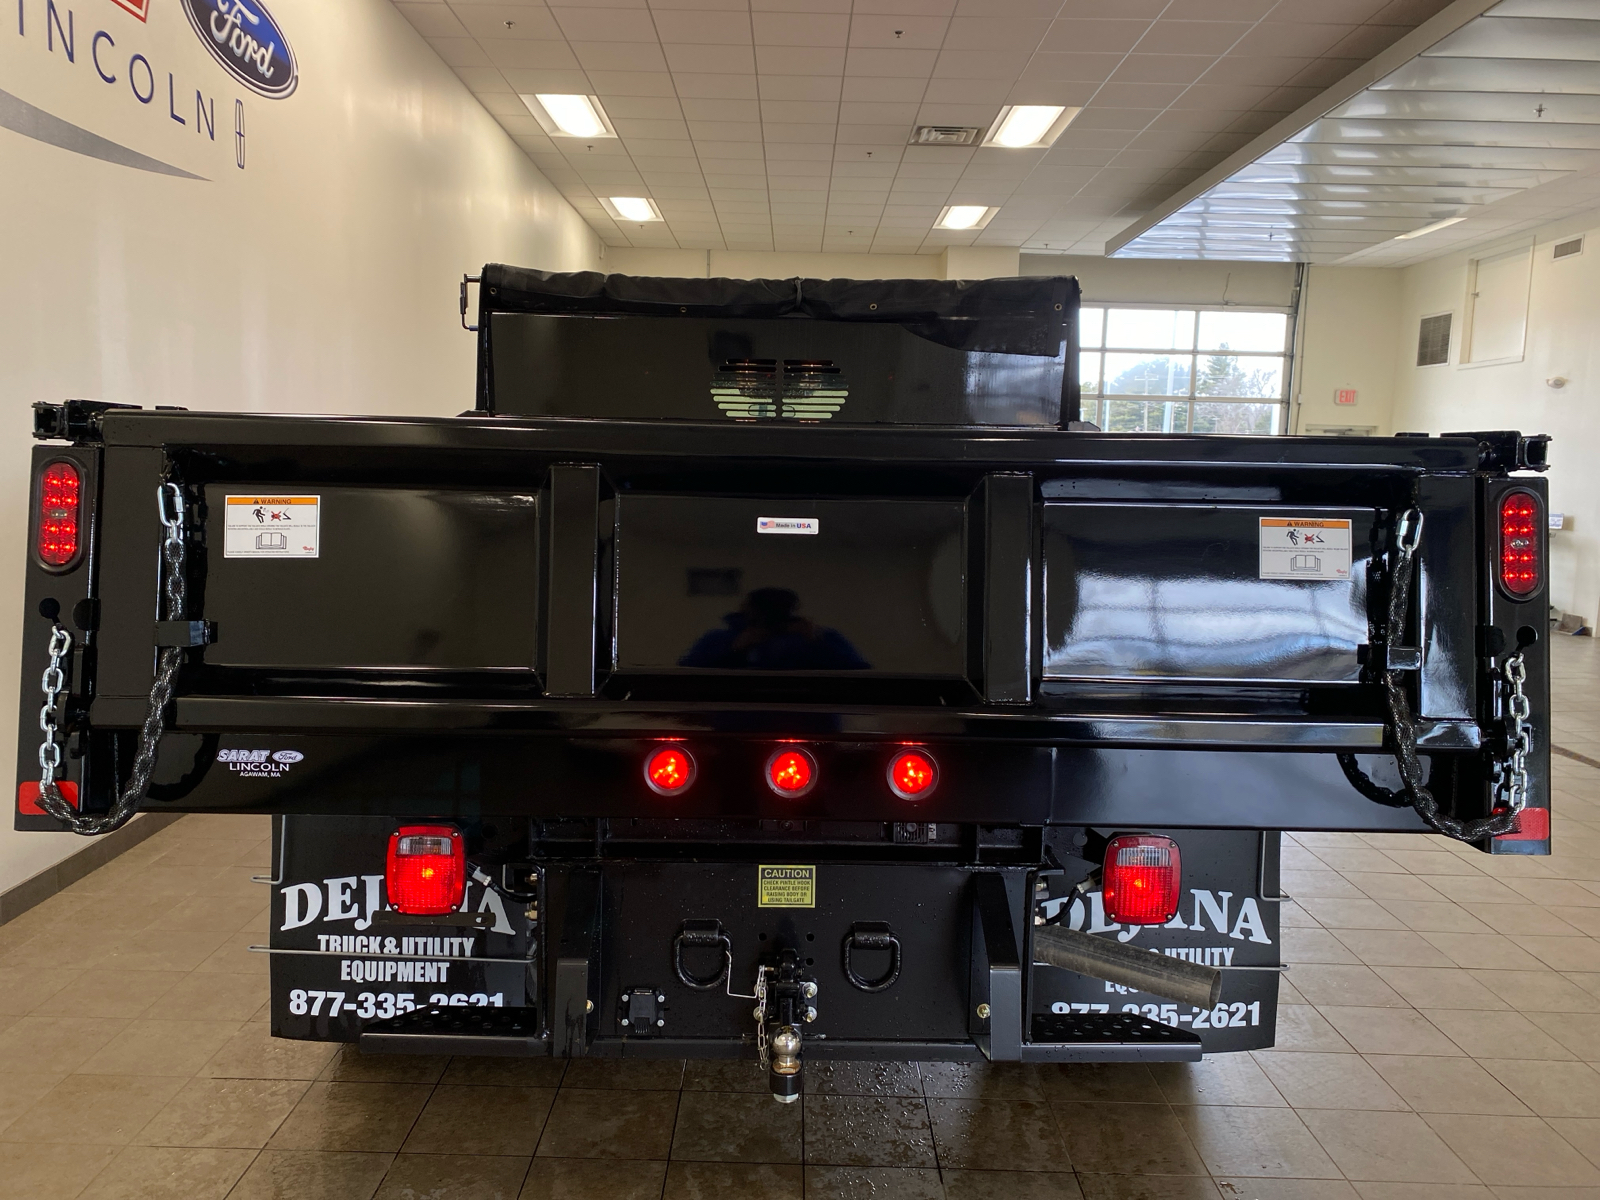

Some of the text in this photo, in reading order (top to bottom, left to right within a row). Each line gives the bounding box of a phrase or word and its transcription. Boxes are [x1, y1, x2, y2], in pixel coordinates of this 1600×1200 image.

[210, 0, 275, 78] Ford
[1339, 389, 1356, 402] EXIT
[217, 749, 270, 762] SARAT
[229, 763, 289, 771] LINCOLN
[764, 869, 810, 878] CAUTION
[280, 875, 516, 935] DEJA
[1041, 889, 1272, 944] DENA
[317, 934, 474, 957] TRUCK & UTILITY
[341, 960, 449, 983] EQUIPMENT
[1051, 1001, 1260, 1029] 35-2621
